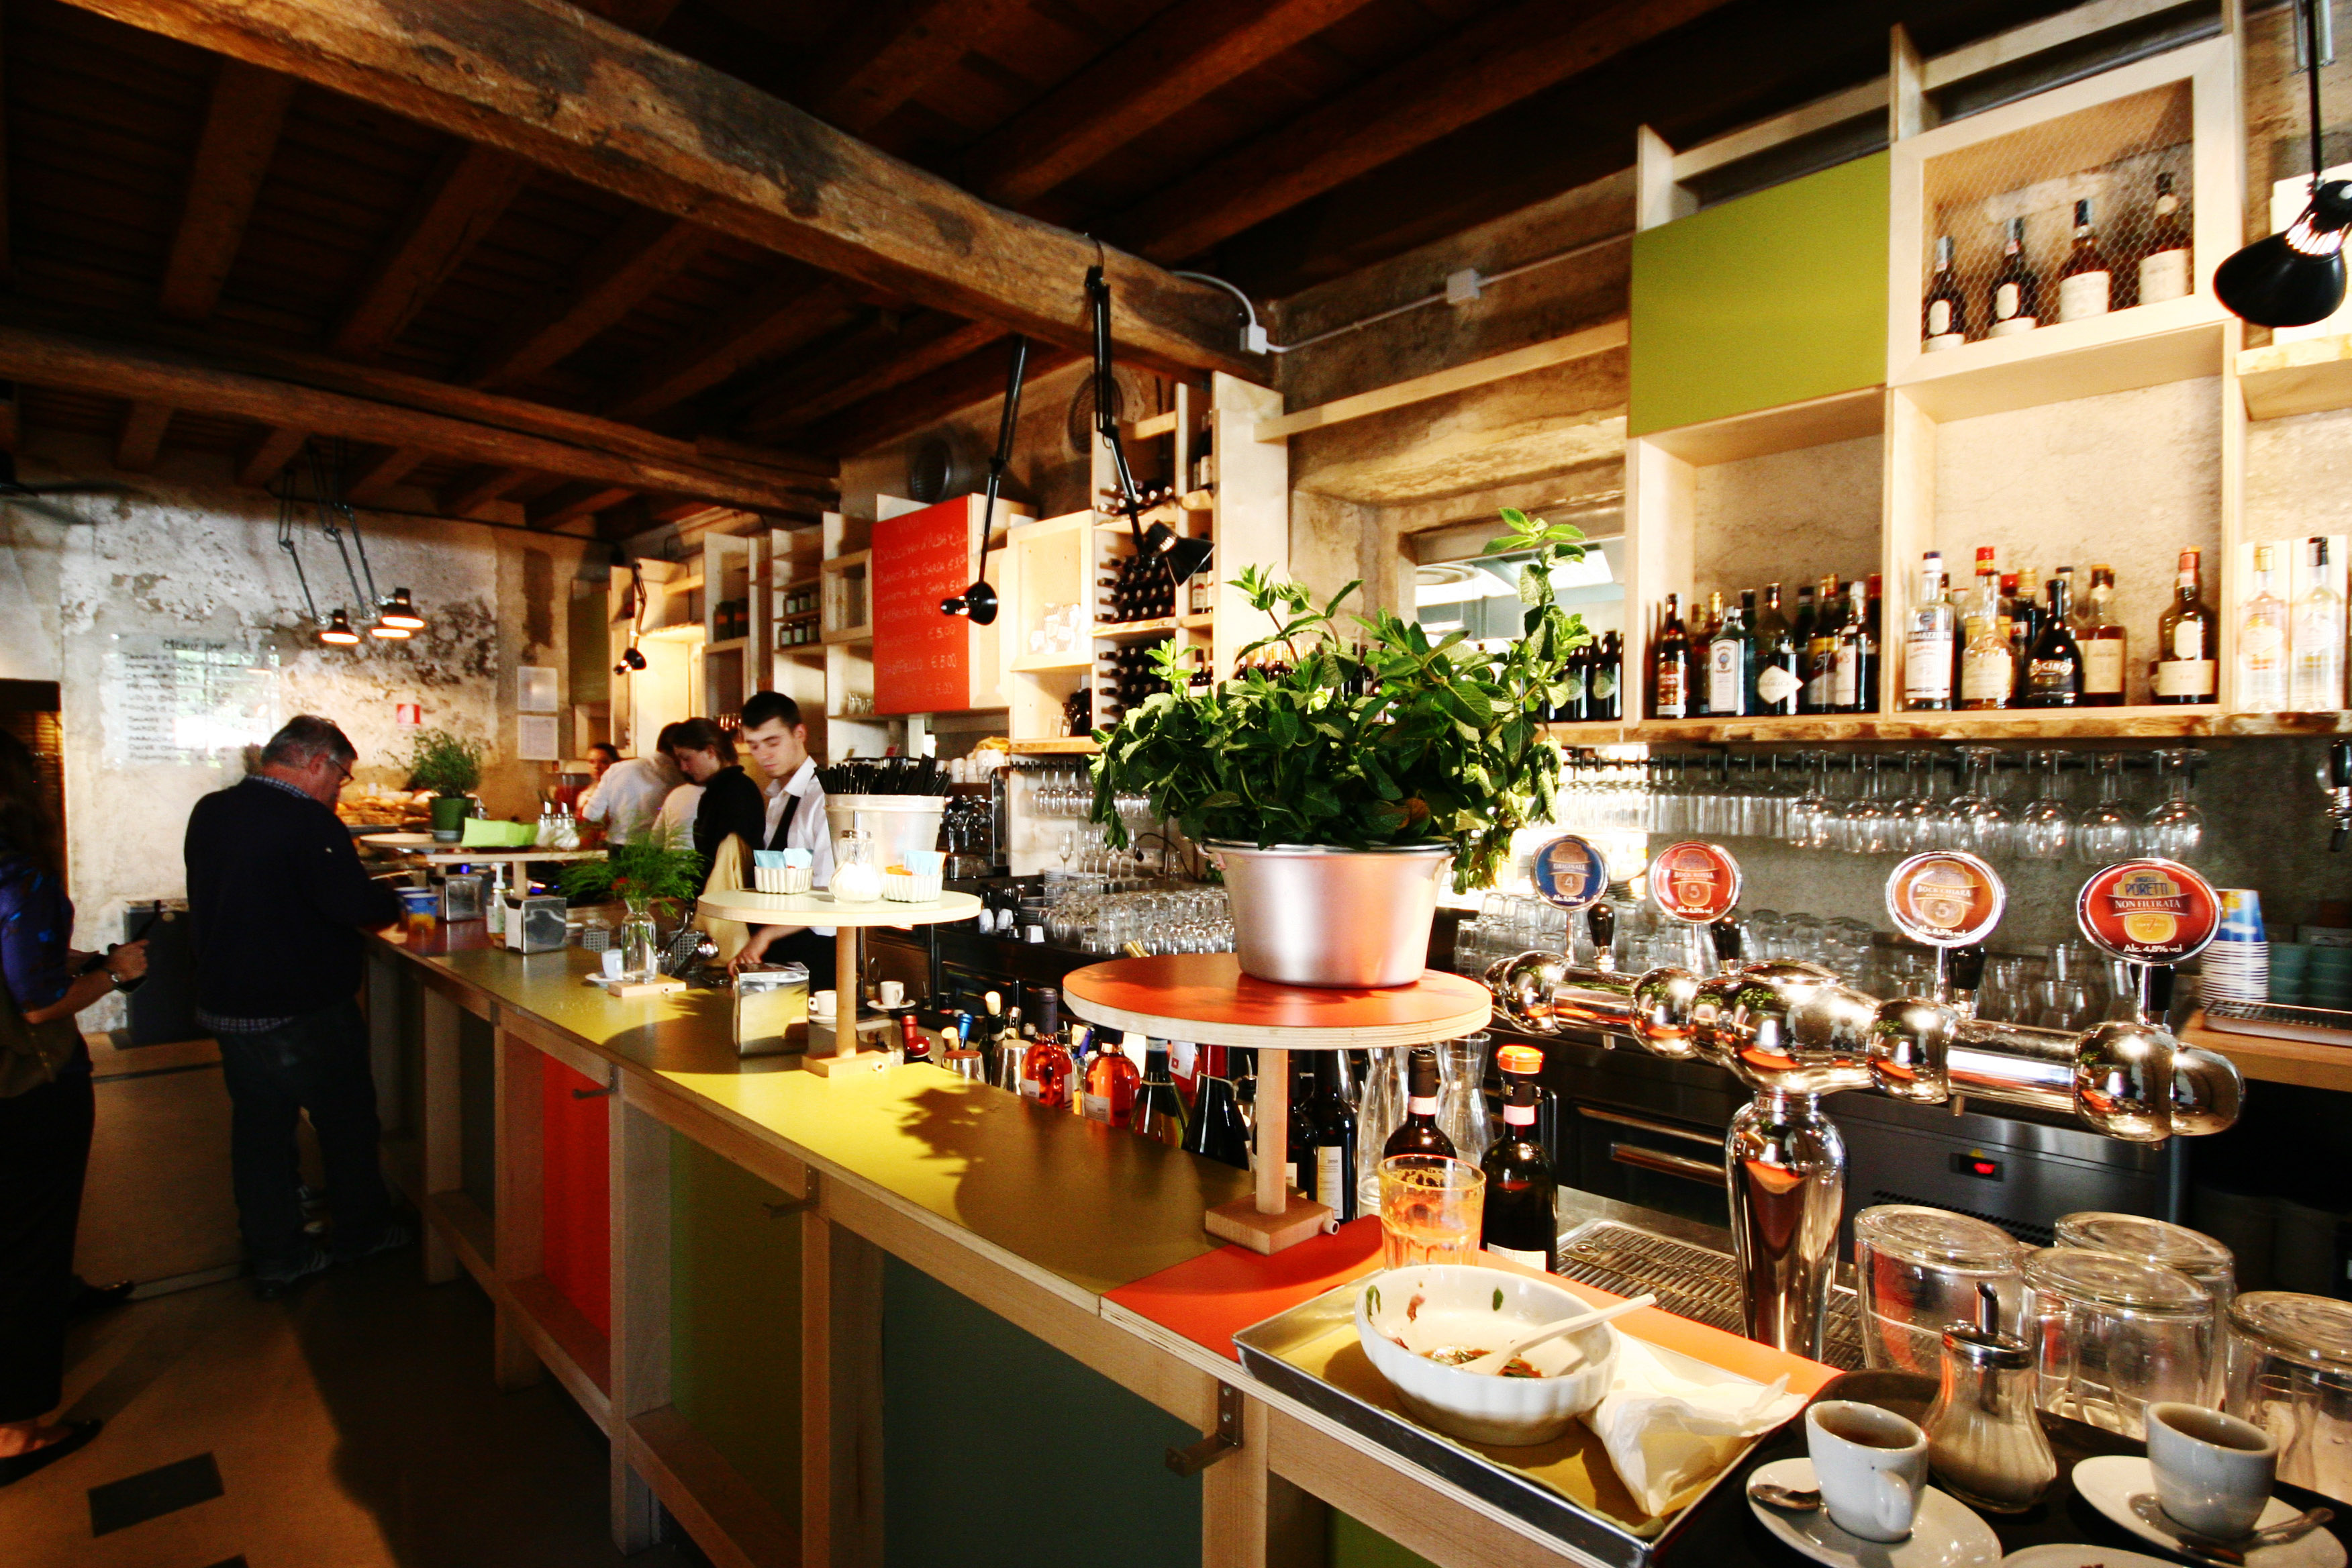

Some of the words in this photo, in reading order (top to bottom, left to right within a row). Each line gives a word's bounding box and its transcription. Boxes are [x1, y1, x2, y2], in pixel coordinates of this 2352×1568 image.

[1564, 875, 1574, 888] 4
[1689, 885, 1700, 898] 5
[1916, 885, 1939, 893] BOCK
[1941, 887, 1971, 897] CHIARA
[2124, 883, 2168, 896] PORETTI
[1934, 902, 1951, 918] 5
[2115, 900, 2136, 908] NON
[2137, 899, 2181, 908] FILTRATA
[2144, 917, 2156, 930] 7
[2169, 944, 2183, 952] vol
